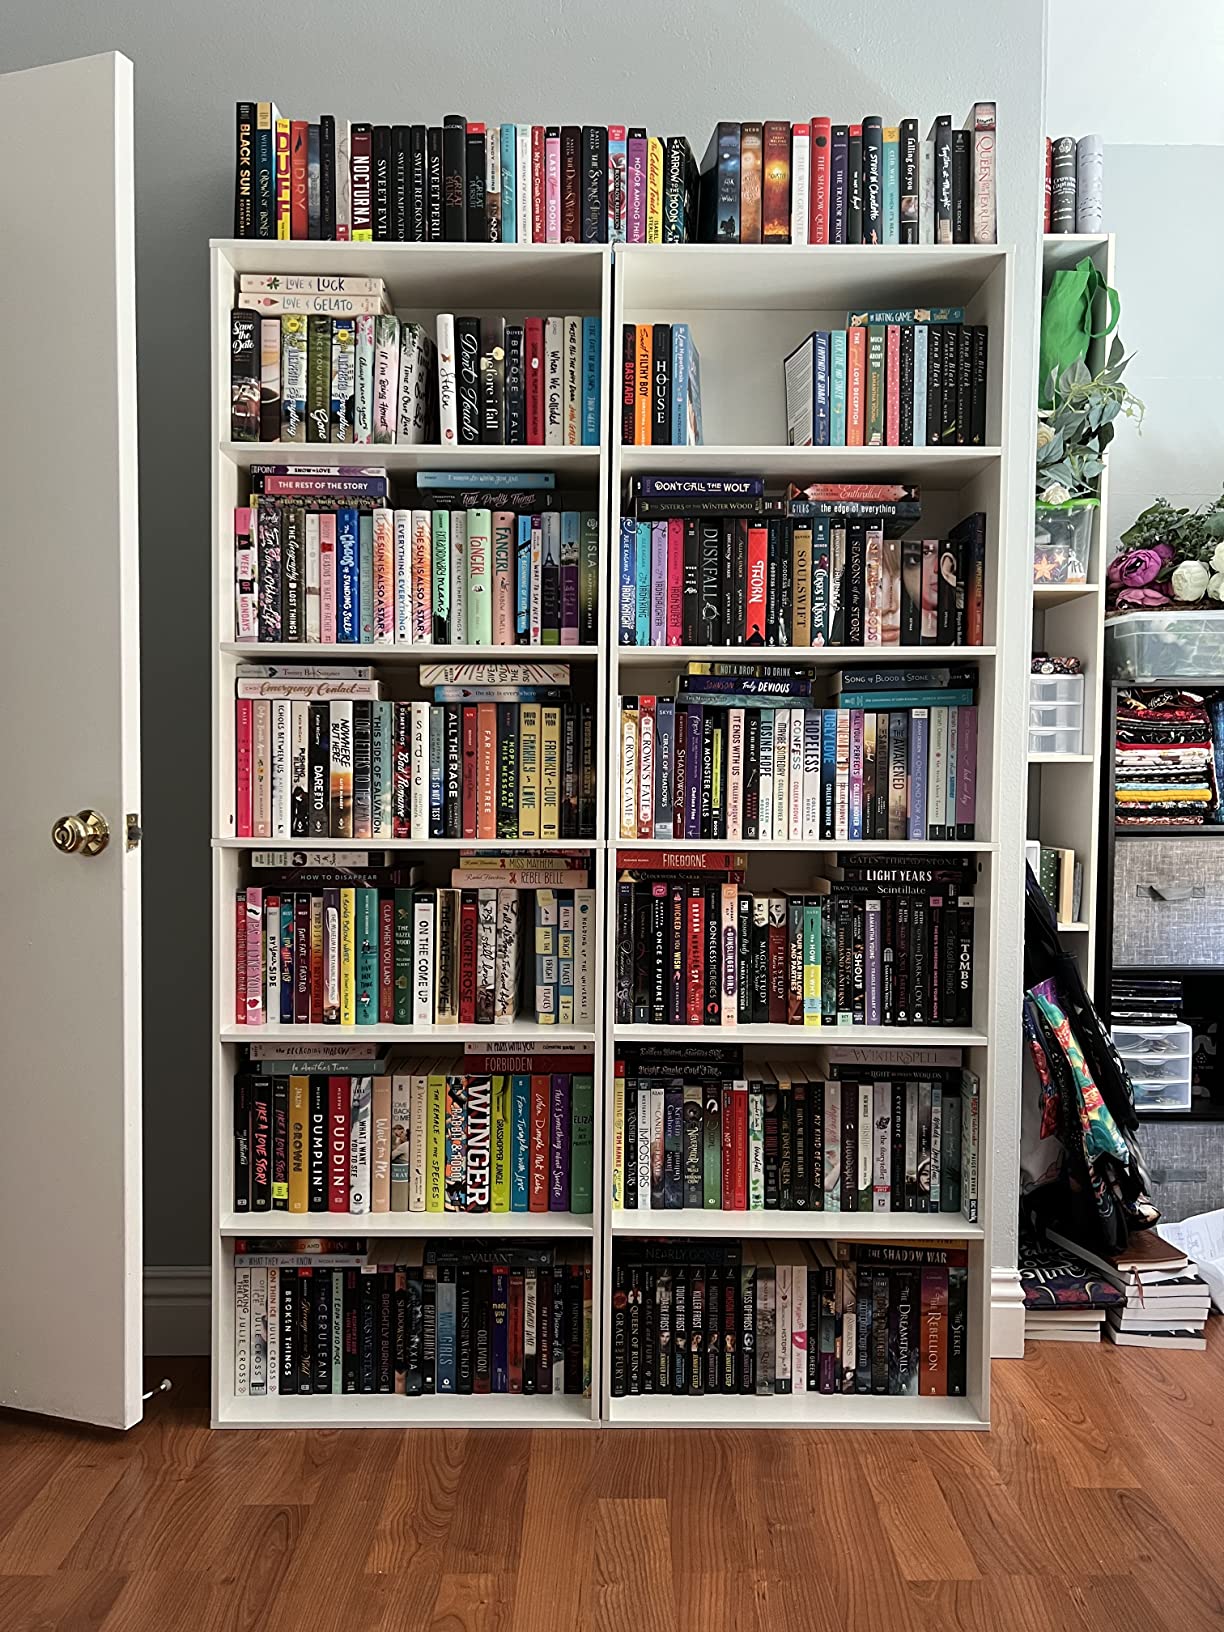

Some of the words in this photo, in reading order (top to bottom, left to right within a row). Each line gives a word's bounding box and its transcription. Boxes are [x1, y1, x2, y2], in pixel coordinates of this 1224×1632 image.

[240, 124, 250, 165] BLACK
[905, 138, 916, 163] falling
[549, 153, 557, 179] LAST
[634, 158, 642, 187] HONOR
[670, 150, 681, 186] ARROW
[817, 157, 825, 172] THE
[240, 170, 250, 195] SUN
[353, 156, 369, 225] NOCTURNA
[378, 160, 386, 204] SWEET
[431, 156, 440, 203] SWEET
[816, 175, 825, 210] SHADOW
[378, 207, 386, 238] EVIL
[431, 203, 441, 239] PERIL
[549, 199, 557, 235] BOOKS
[669, 194, 680, 223] MOON
[633, 219, 641, 243] THIEV
[286, 276, 304, 290] LOVE
[317, 278, 344, 291] LUCK
[283, 294, 301, 309] LOVE
[314, 296, 352, 311] GELATO
[234, 321, 254, 334] Save
[233, 340, 254, 354] Date
[550, 351, 560, 376] When
[640, 354, 648, 380] FILTHY
[440, 368, 455, 410] Stolen
[624, 362, 634, 405] BASTARD
[640, 381, 648, 396] BOY
[657, 361, 669, 423] HOUSE
[460, 387, 478, 440] Touch
[549, 393, 560, 425] Collided
[655, 481, 682, 490] DON'T
[683, 482, 706, 491] CALL
[724, 483, 750, 492] WOLF
[660, 502, 684, 510] SISTERS
[702, 502, 728, 510] WINTER
[730, 502, 752, 510] WOOD
[834, 505, 850, 514] edge
[851, 505, 859, 513] of
[861, 505, 896, 514] everything
[240, 554, 249, 575] WEEK
[496, 527, 511, 576] FANGIRL
[588, 540, 597, 568] ISLA
[703, 528, 719, 602] DUSKFALL
[851, 540, 860, 586] SEASONS
[378, 564, 384, 572] IS
[417, 566, 424, 574] IS
[749, 561, 764, 604] THORN
[377, 574, 385, 598] ALSO
[797, 551, 806, 627] SOULSWIFT
[240, 596, 250, 631] MONDAYS
[417, 610, 425, 632] STAR
[851, 606, 860, 642] STORM
[260, 682, 313, 696] Emergency
[317, 683, 357, 695] Contact
[758, 681, 790, 693] DEVIOUS
[332, 723, 340, 738] BUT
[373, 716, 381, 736] THIS
[449, 713, 458, 735] ALL
[761, 720, 772, 752] LOSING
[823, 714, 836, 735] UGLY
[332, 739, 340, 763] HERE
[340, 718, 350, 768] NOWHERE
[374, 739, 382, 760] SIDE
[449, 736, 458, 764] THE
[793, 720, 802, 770] CONFESS
[805, 719, 819, 773] HOPELESS
[823, 737, 835, 764] LOVE
[373, 763, 382, 779] OF
[397, 752, 408, 774] Bad
[544, 740, 556, 777] FRANKLY
[703, 747, 711, 790] MONSTER
[760, 753, 772, 777] HOPE
[892, 738, 904, 790] AWAKENED
[449, 764, 458, 798] RAGE
[372, 781, 381, 834] SALVATION
[397, 775, 409, 818] Romance
[544, 786, 556, 807] LOVE
[702, 791, 710, 817] CALLS
[510, 858, 524, 867] MISS
[527, 858, 553, 868] MAYHEM
[663, 853, 706, 868] FIREBORNE
[521, 872, 541, 884] REBEL
[544, 872, 563, 884] BELLE
[866, 870, 898, 881] LIGHT
[900, 870, 932, 882] YEARS
[877, 885, 926, 895] Scintillate
[384, 904, 392, 923] CLAP
[419, 921, 428, 933] ON
[384, 925, 392, 946] WHEN
[419, 936, 428, 955] THE
[463, 918, 472, 969] CONCRETE
[709, 921, 717, 964] BONELESS
[384, 948, 392, 964] YOU
[959, 944, 971, 989] TOMBS
[384, 966, 392, 986] LAND
[418, 958, 428, 987] COME
[854, 953, 863, 989] SHOUT
[418, 989, 427, 1003] UP
[463, 970, 472, 1003] ROSE
[485, 1057, 533, 1071] FORBIDDEN
[574, 1115, 592, 1123] ELIZA
[313, 1115, 323, 1192] DUMPLIN'
[333, 1115, 345, 1194] PUDDIN'
[466, 1082, 491, 1206] WINGER
[496, 1119, 504, 1161] GRASSHOPPER
[639, 1128, 649, 1188] IMPOSTORS
[432, 1162, 440, 1199] SPECIES
[884, 1249, 923, 1262] SHADOW
[927, 1252, 947, 1263] WAR
[254, 1313, 262, 1338] JULIE
[284, 1290, 292, 1332] BROKEN
[382, 1293, 390, 1336] BRIGHTLY
[317, 1304, 328, 1378] CERULEAN
[440, 1336, 453, 1365] GIRLS
[478, 1329, 487, 1372] OBLIVION
[899, 1304, 911, 1374] DREAMTRAILS
[927, 1312, 942, 1372] REBELLION
[952, 1324, 964, 1356] SEEKER
[254, 1344, 262, 1376] CROSS
[284, 1338, 292, 1376] THINGS
